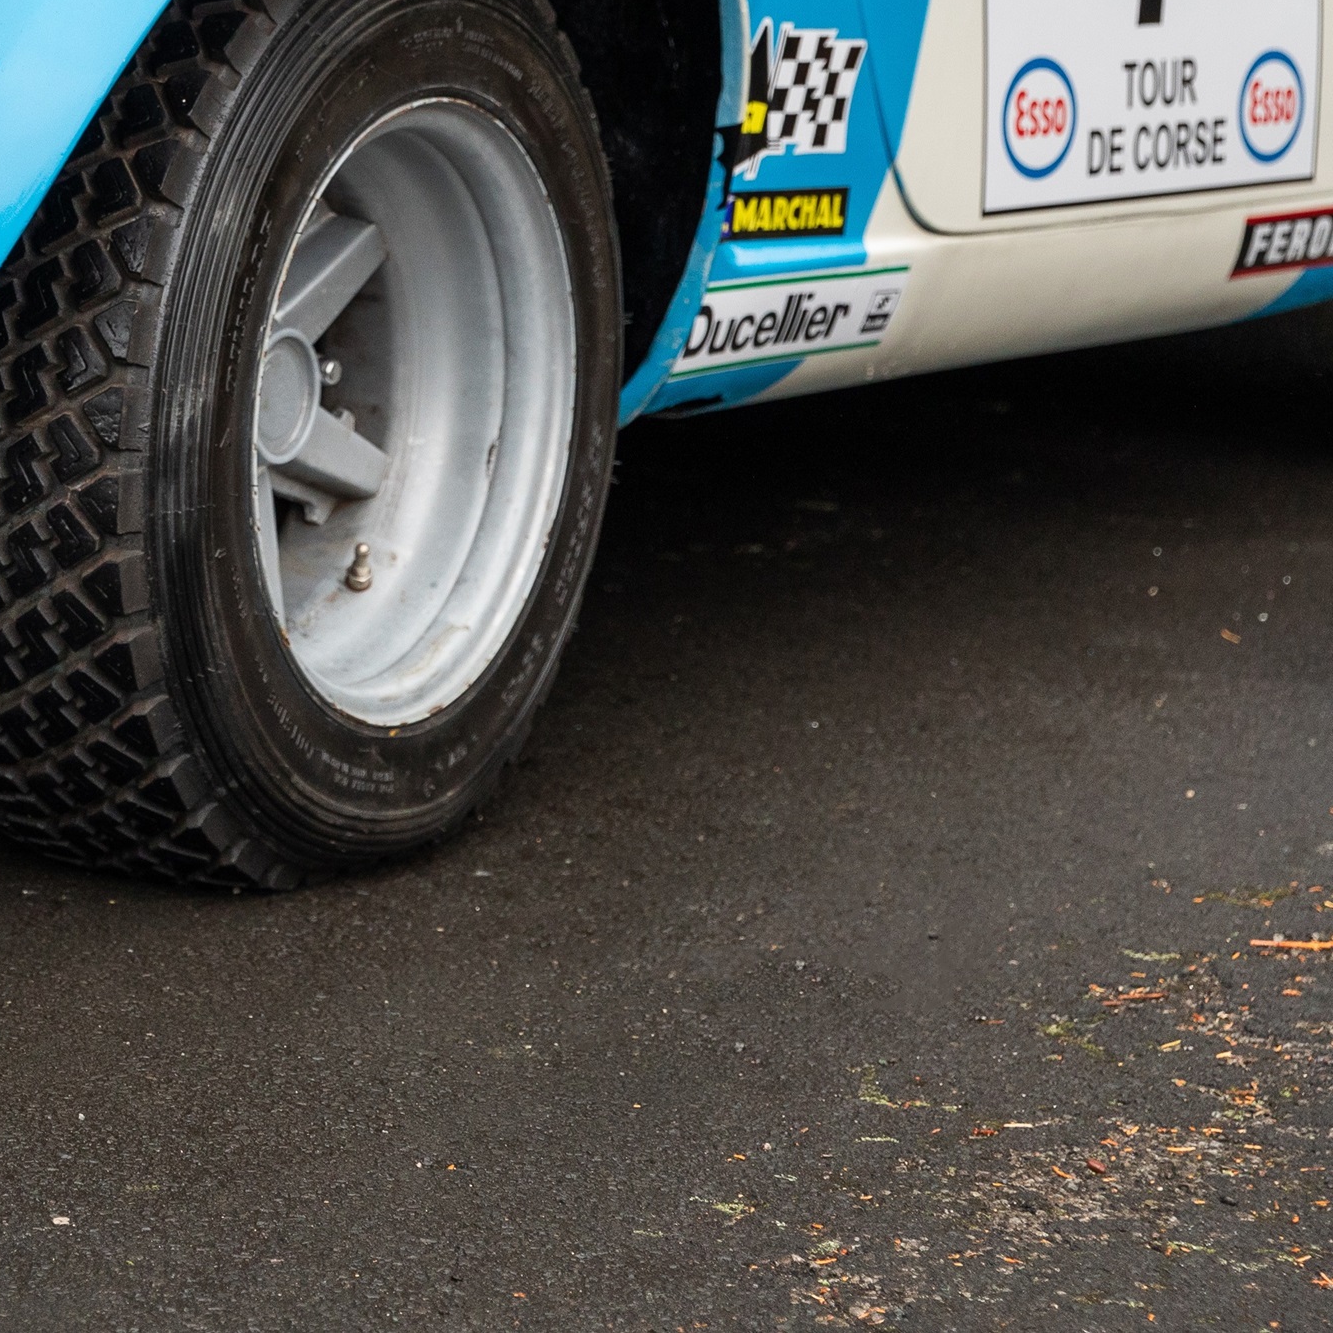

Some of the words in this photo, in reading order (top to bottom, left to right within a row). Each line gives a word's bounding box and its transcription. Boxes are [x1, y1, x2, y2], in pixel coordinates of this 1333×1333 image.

[1123, 58, 1198, 110] TOUR
[1248, 78, 1296, 127] Esso
[1013, 89, 1067, 139] Esso
[1087, 126, 1126, 178] DE
[1132, 117, 1227, 172] CORSE
[733, 193, 844, 233] MARCHAL
[1243, 214, 1333, 267] FERO
[683, 292, 851, 358] Ducellier
